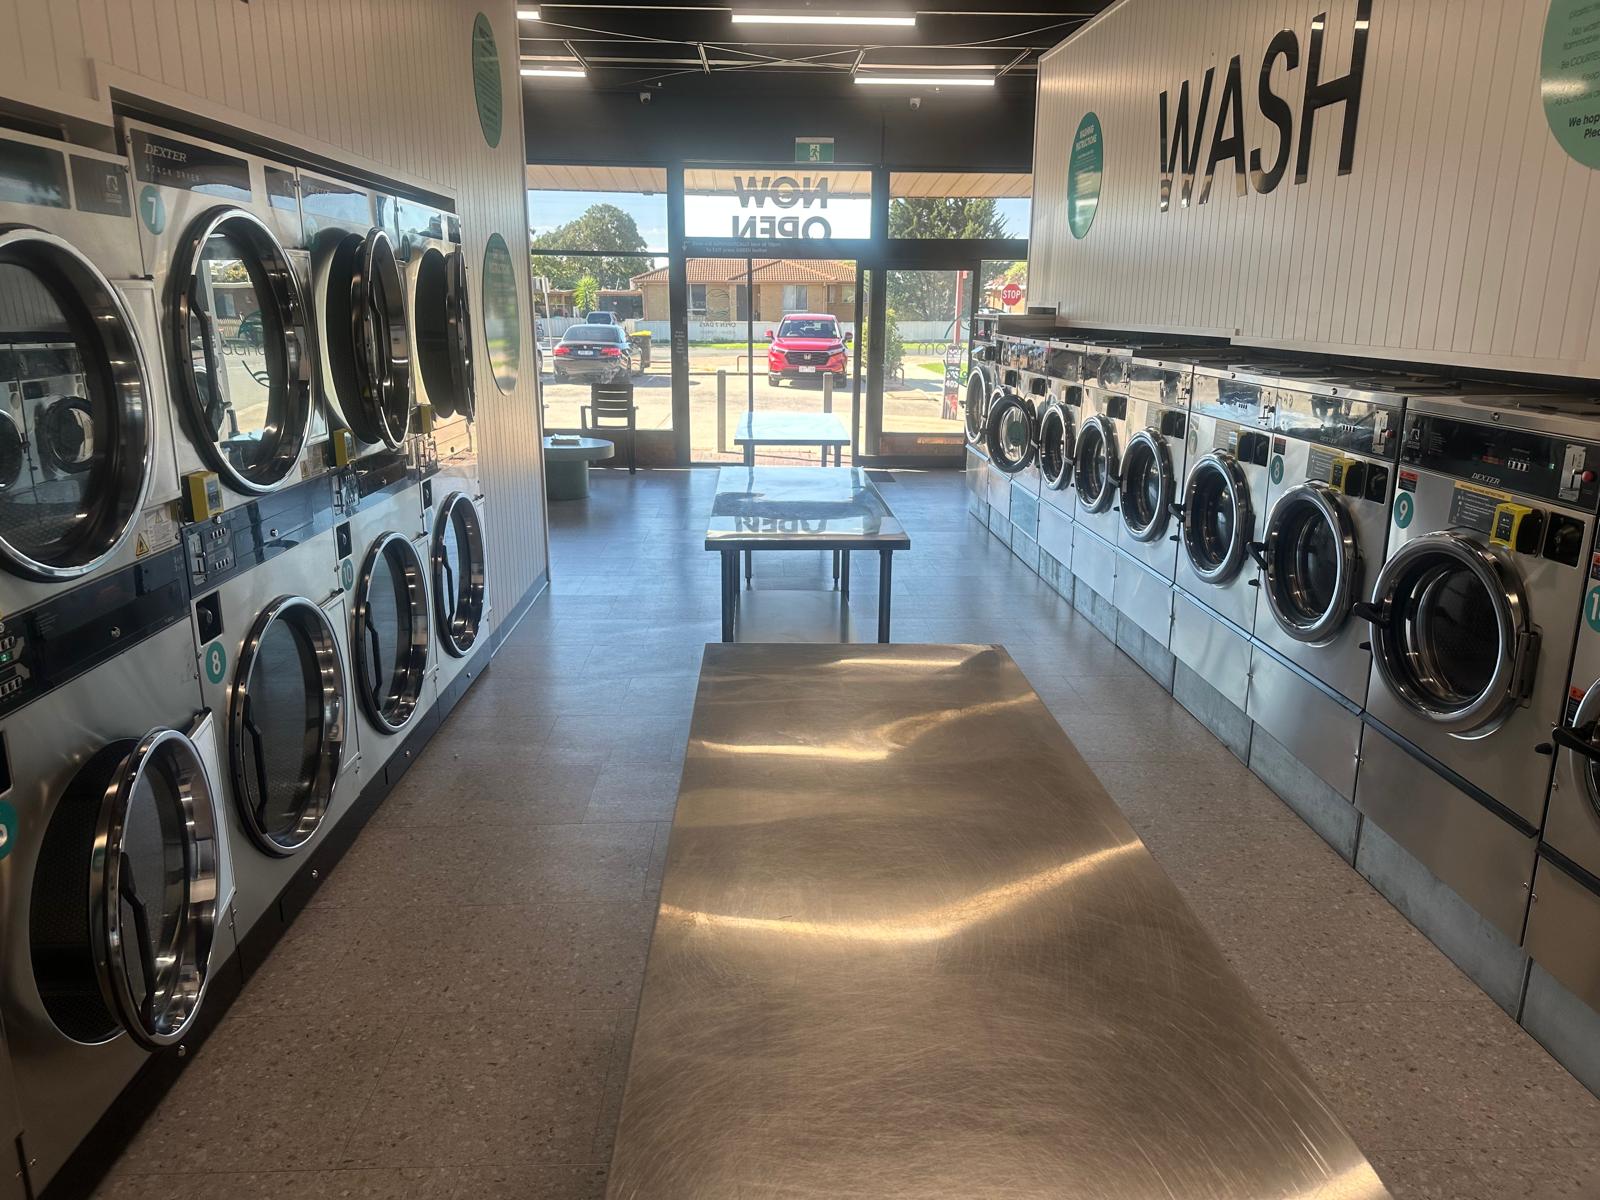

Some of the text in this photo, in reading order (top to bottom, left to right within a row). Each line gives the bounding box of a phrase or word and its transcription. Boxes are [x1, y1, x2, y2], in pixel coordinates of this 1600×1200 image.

[1159, 0, 1372, 213] WASH
[1569, 117, 1582, 128] We
[144, 143, 187, 163] DEXTER
[147, 196, 157, 225] 7
[1002, 289, 1022, 299] STOP
[1273, 461, 1280, 479] 8
[1471, 472, 1501, 485] DEXTER
[1400, 500, 1409, 521] 9
[343, 564, 353, 585] 10
[1591, 592, 1600, 621] 1
[212, 650, 221, 675] 8
